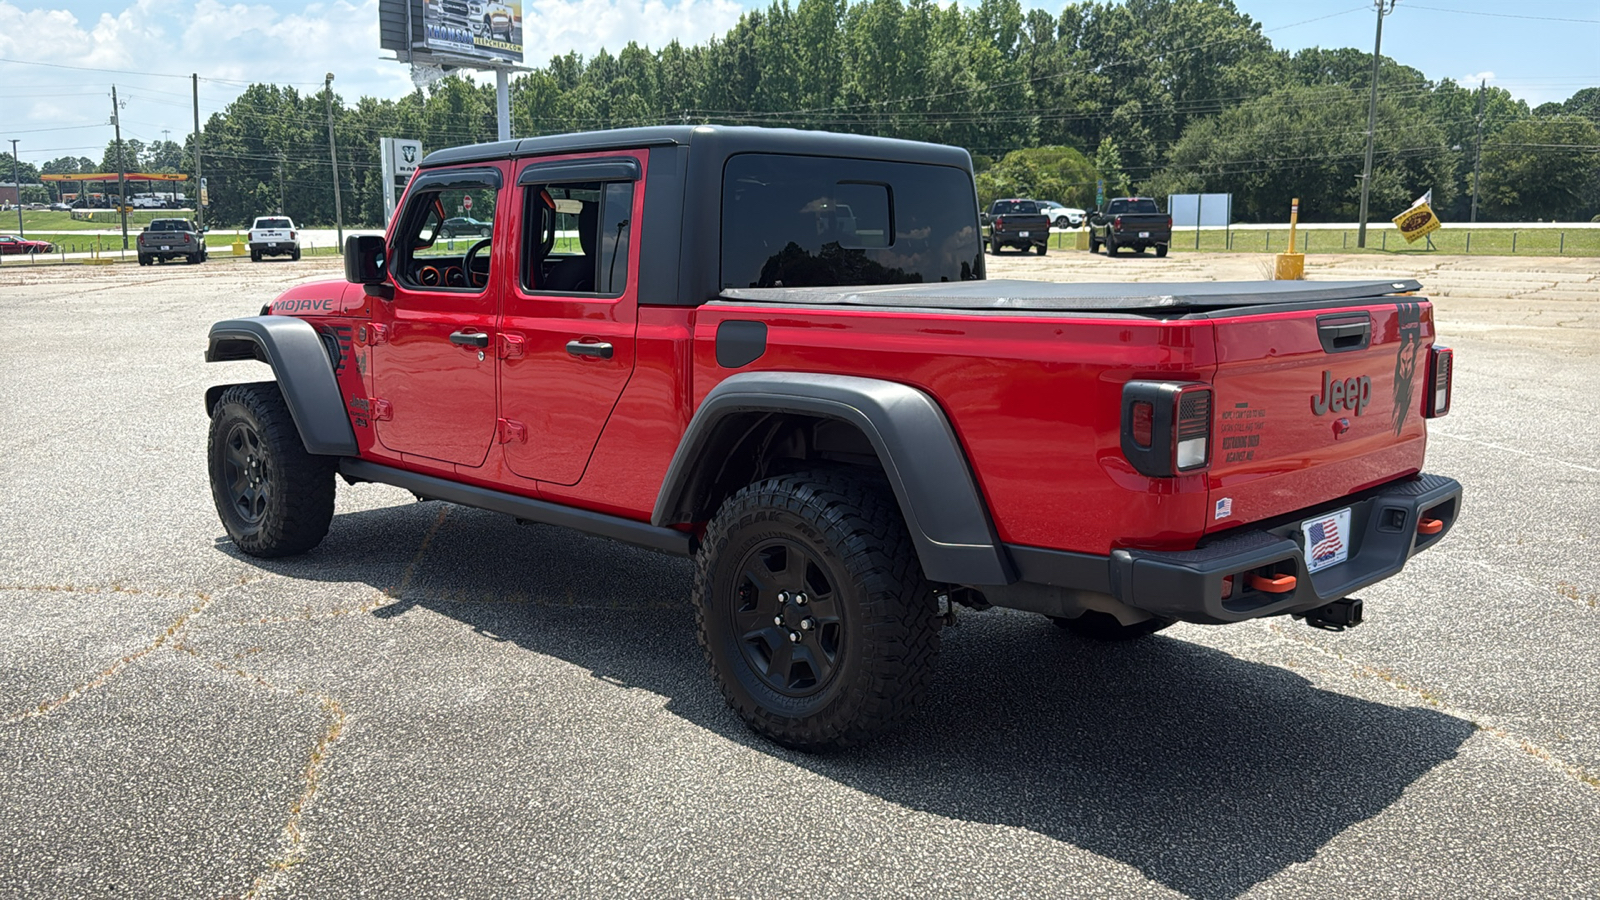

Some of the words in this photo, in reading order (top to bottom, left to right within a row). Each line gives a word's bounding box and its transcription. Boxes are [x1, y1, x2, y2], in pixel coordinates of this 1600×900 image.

[427, 24, 474, 45] THOMSON
[474, 37, 522, 52] JEEPCHEAP.COM
[272, 299, 333, 313] MOJAVE
[1311, 370, 1372, 416] Jeep
